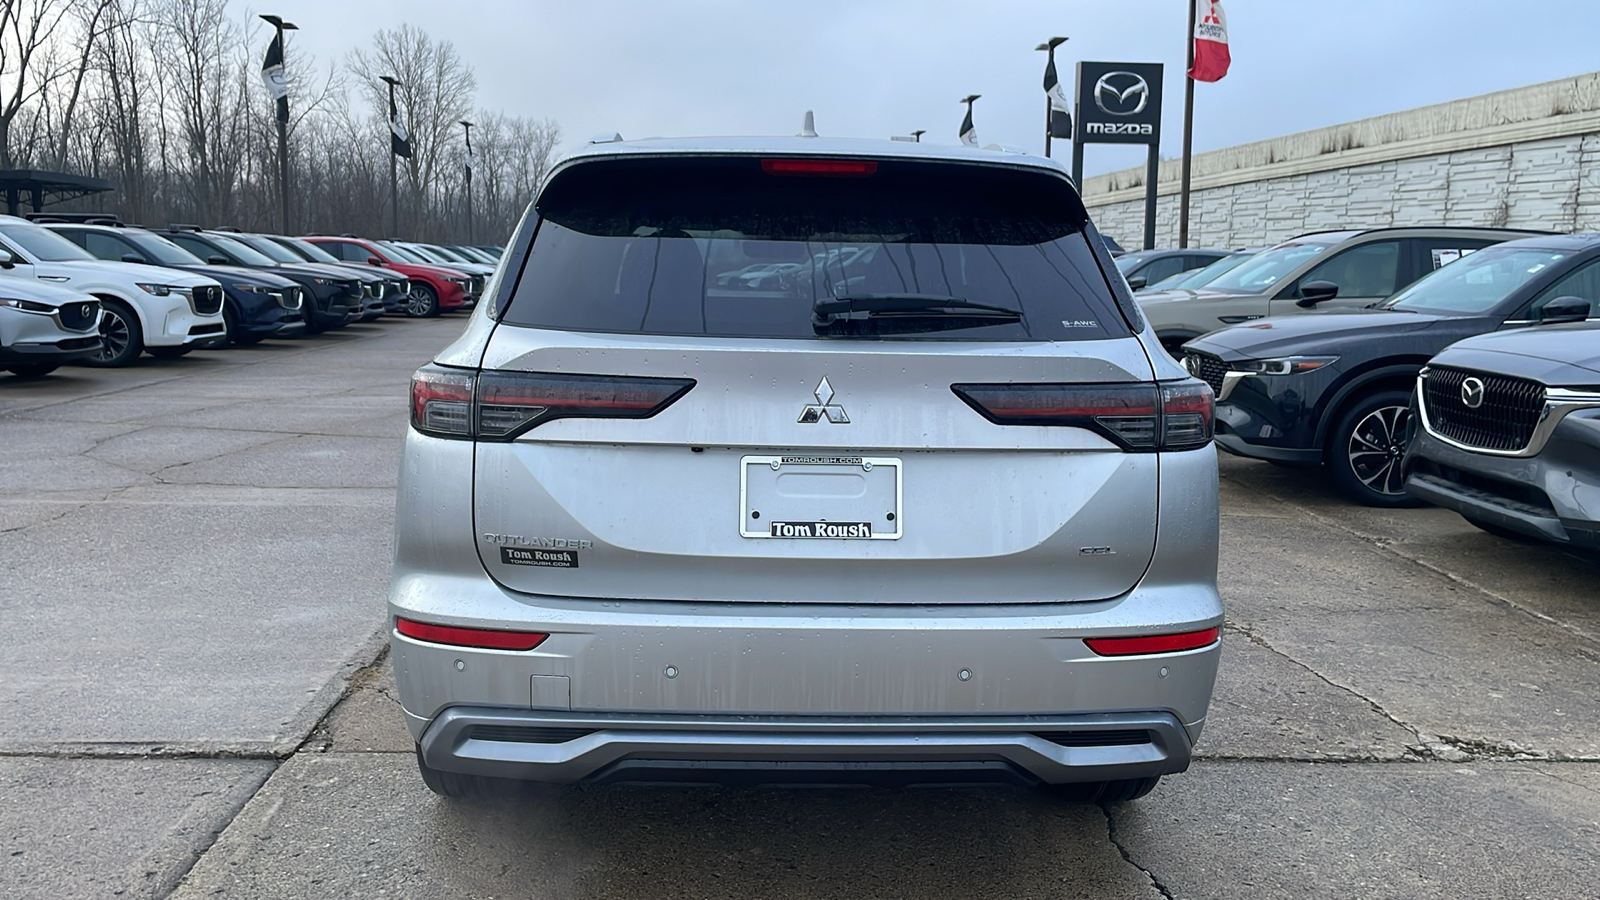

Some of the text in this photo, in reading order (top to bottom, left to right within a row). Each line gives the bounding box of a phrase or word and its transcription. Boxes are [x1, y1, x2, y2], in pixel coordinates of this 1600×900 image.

[1086, 122, 1153, 136] mazda
[782, 456, 863, 464] TOMROUSH.COM
[772, 523, 871, 538] Tom Roush
[484, 532, 594, 549] OUTLANDER
[506, 548, 572, 562] Tom Roush
[510, 559, 571, 568] TOMROUSH.COM
